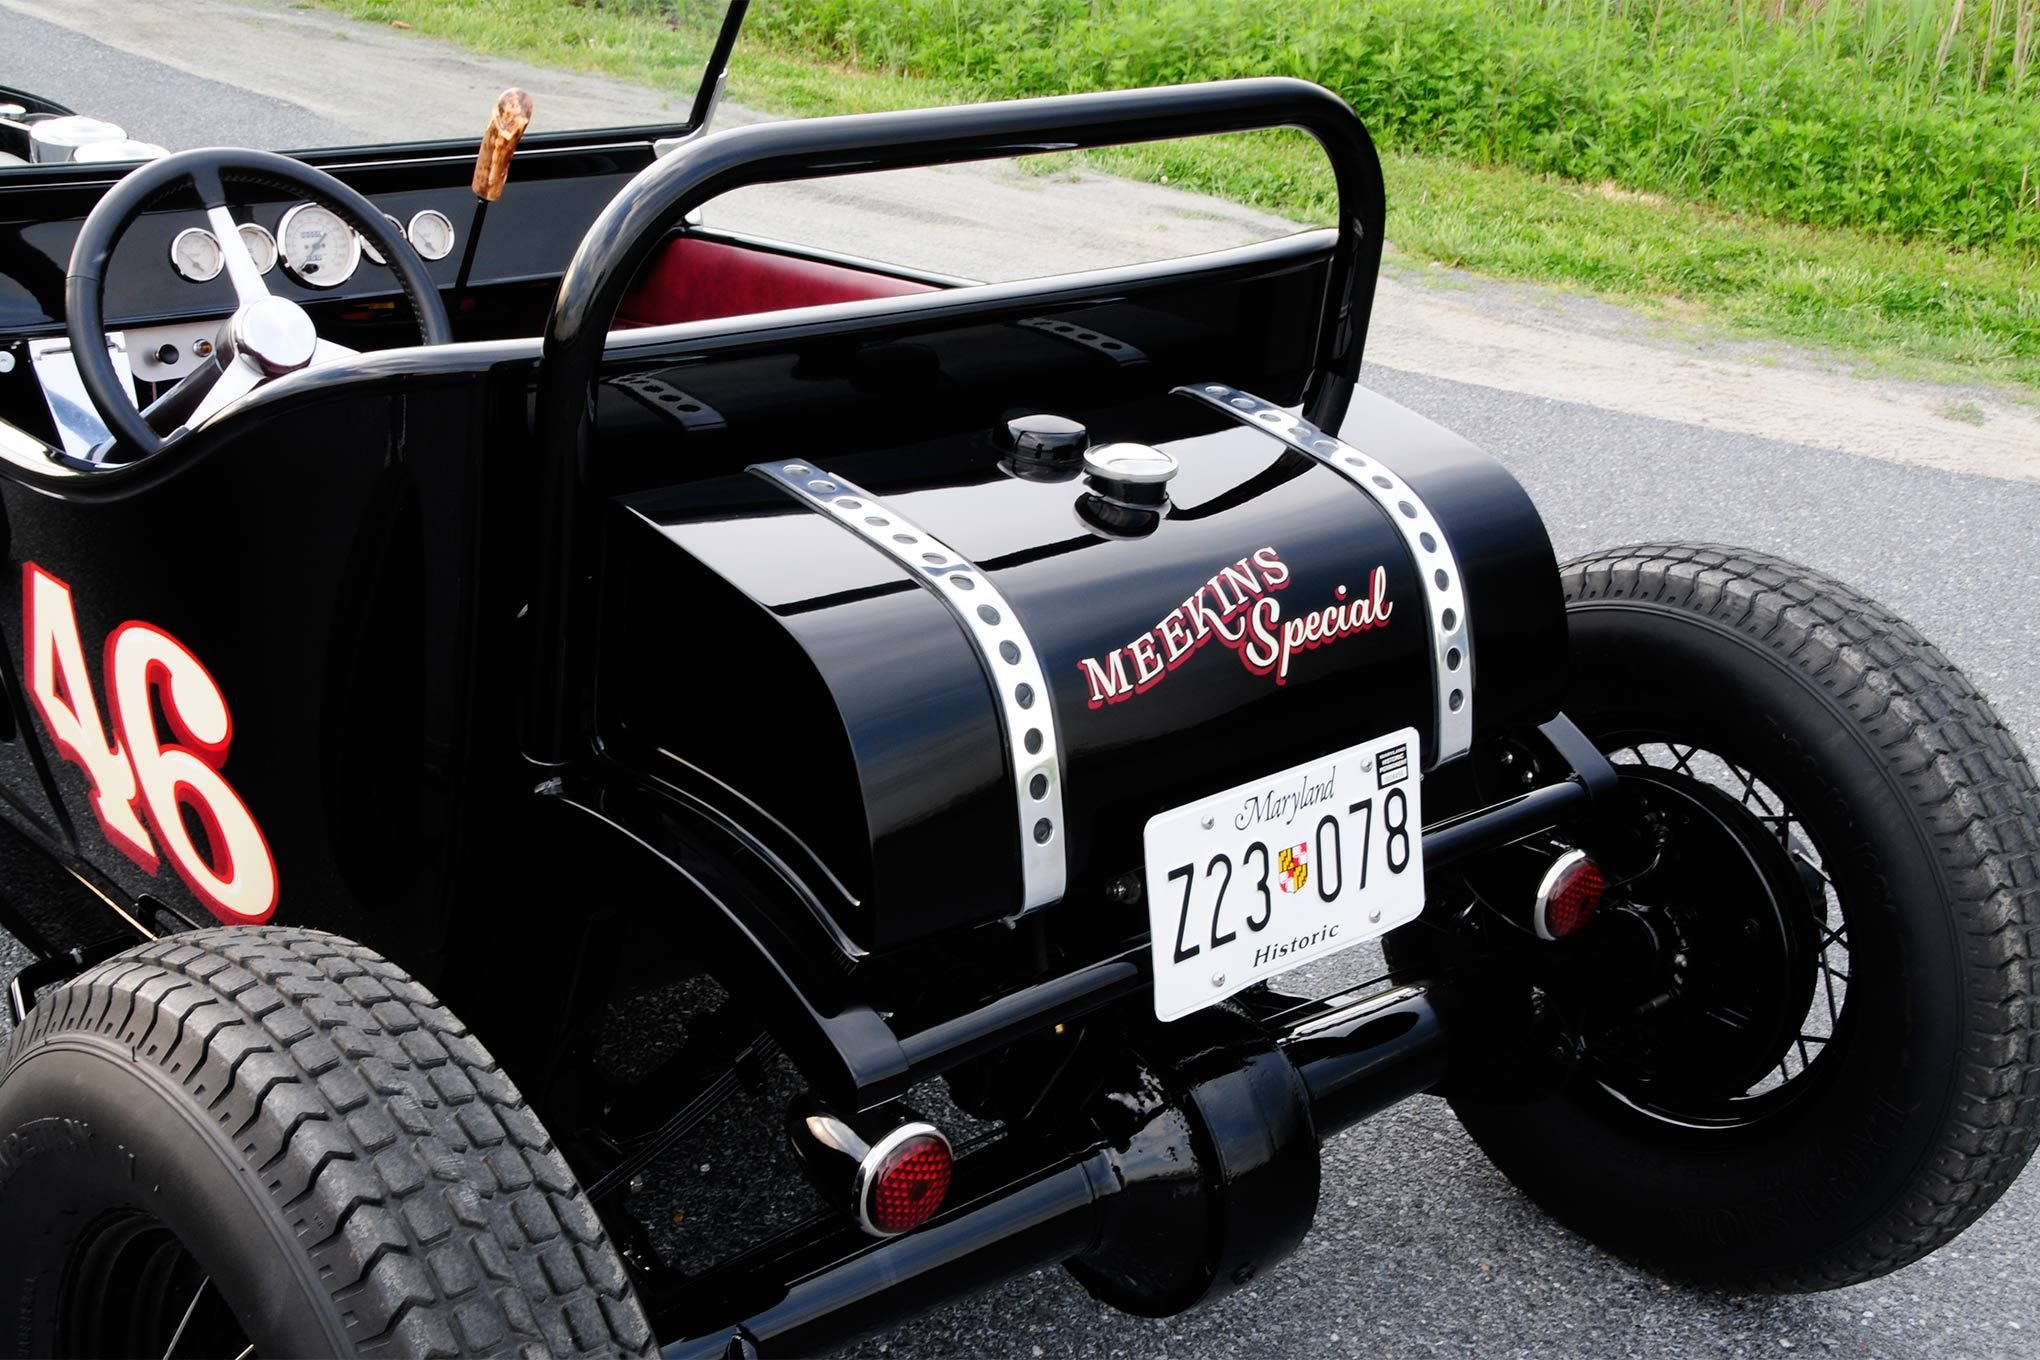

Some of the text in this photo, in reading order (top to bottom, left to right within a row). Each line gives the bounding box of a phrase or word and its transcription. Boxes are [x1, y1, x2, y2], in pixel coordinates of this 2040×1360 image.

[1077, 546, 1291, 710] MEEKINS
[1239, 565, 1393, 686] Special
[22, 560, 279, 926] 46
[1235, 766, 1337, 831] Maryland
[1167, 787, 1410, 964] Z23 078
[1253, 924, 1340, 968] Historic
